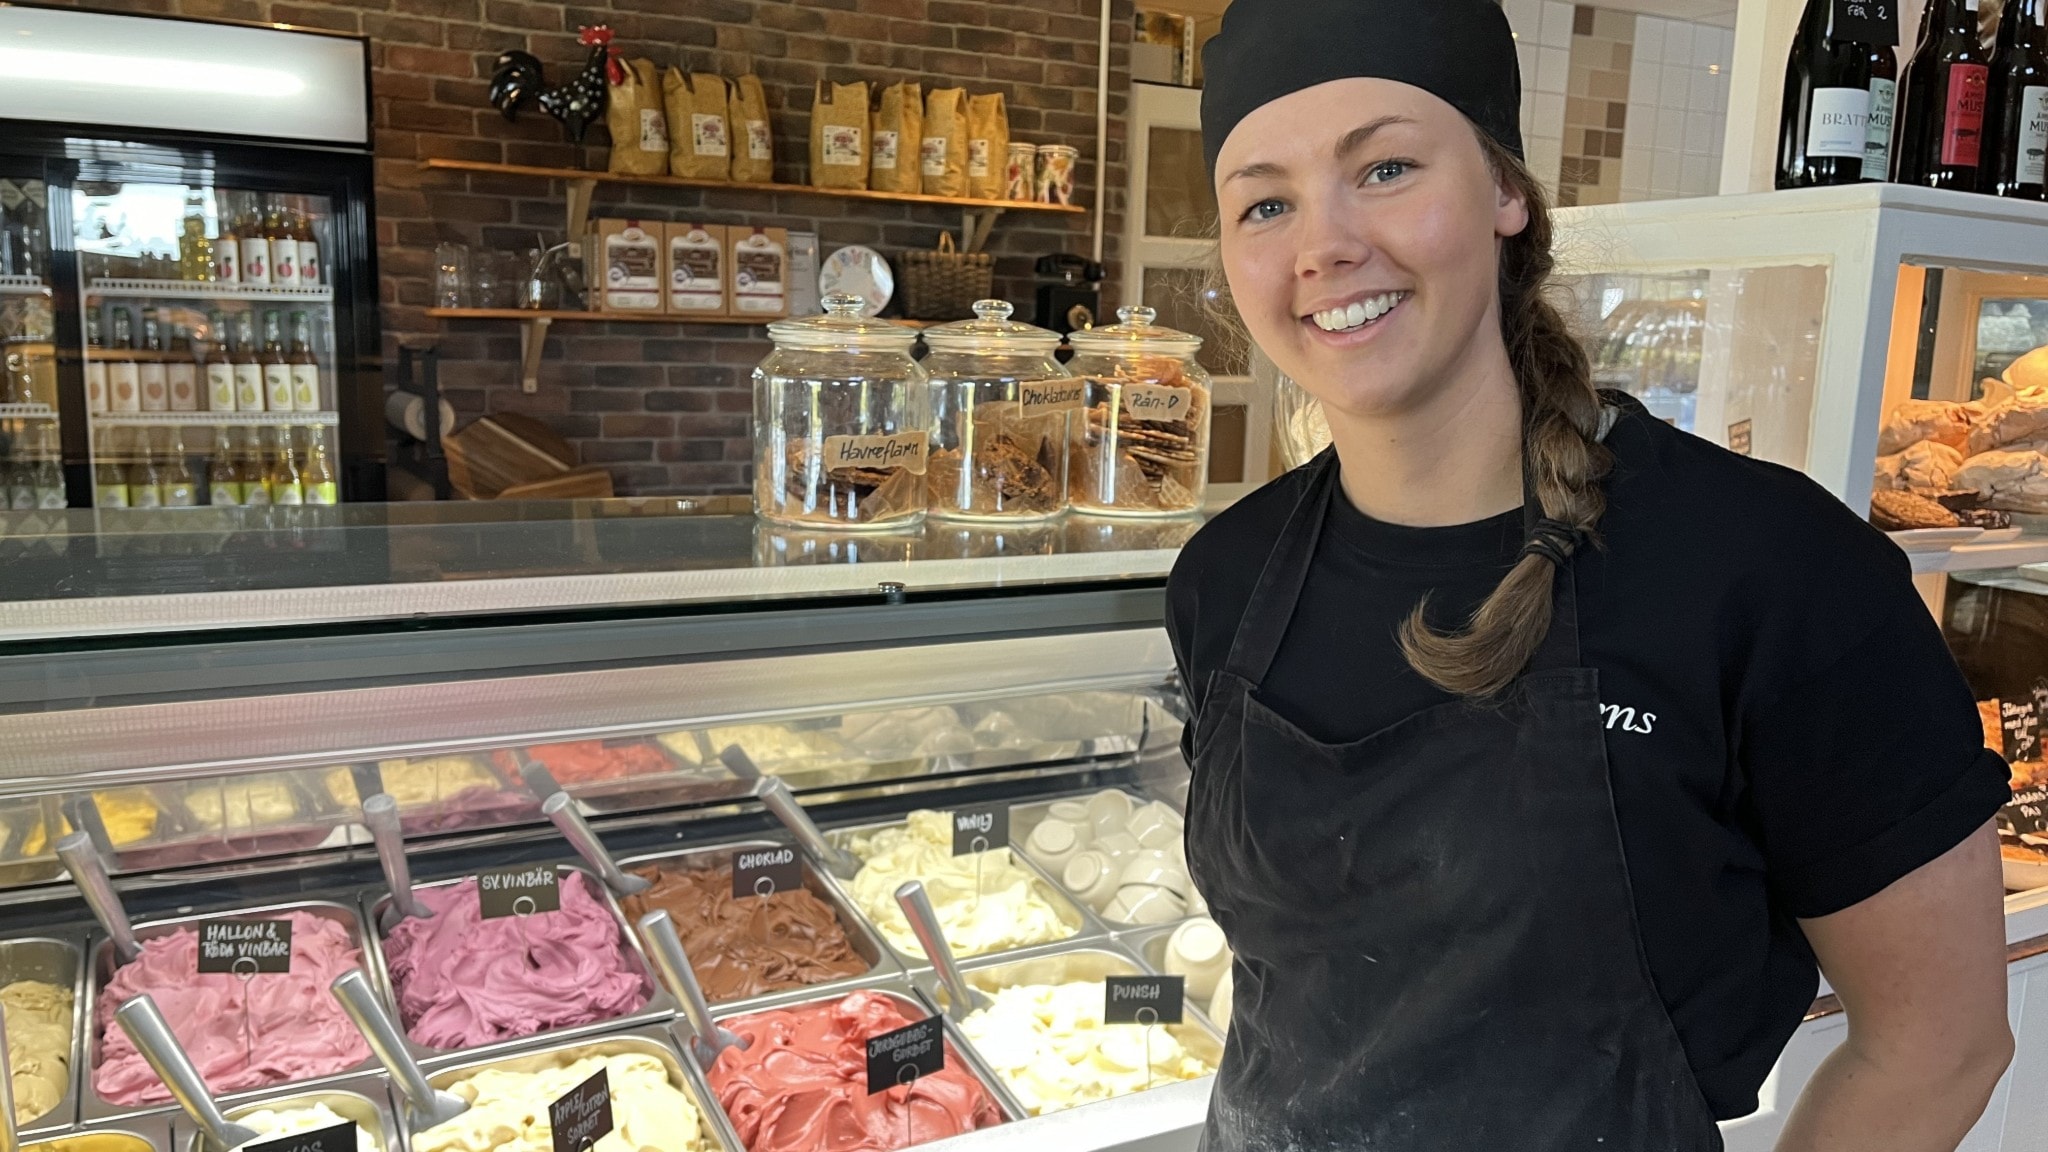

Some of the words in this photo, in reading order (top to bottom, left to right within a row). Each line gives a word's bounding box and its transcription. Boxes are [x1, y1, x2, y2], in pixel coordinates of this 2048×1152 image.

[1877, 5, 1888, 20] 2
[1957, 99, 1982, 112] MUS
[1822, 112, 1868, 128] BRATT
[1868, 111, 1893, 128] MUS
[738, 848, 794, 870] CHOKLAD
[207, 923, 264, 941] HALLON
[266, 921, 278, 940] &
[238, 937, 289, 957] VINBÄR
[1112, 983, 1161, 1002] PUNSH
[567, 1109, 601, 1145] SORBET
